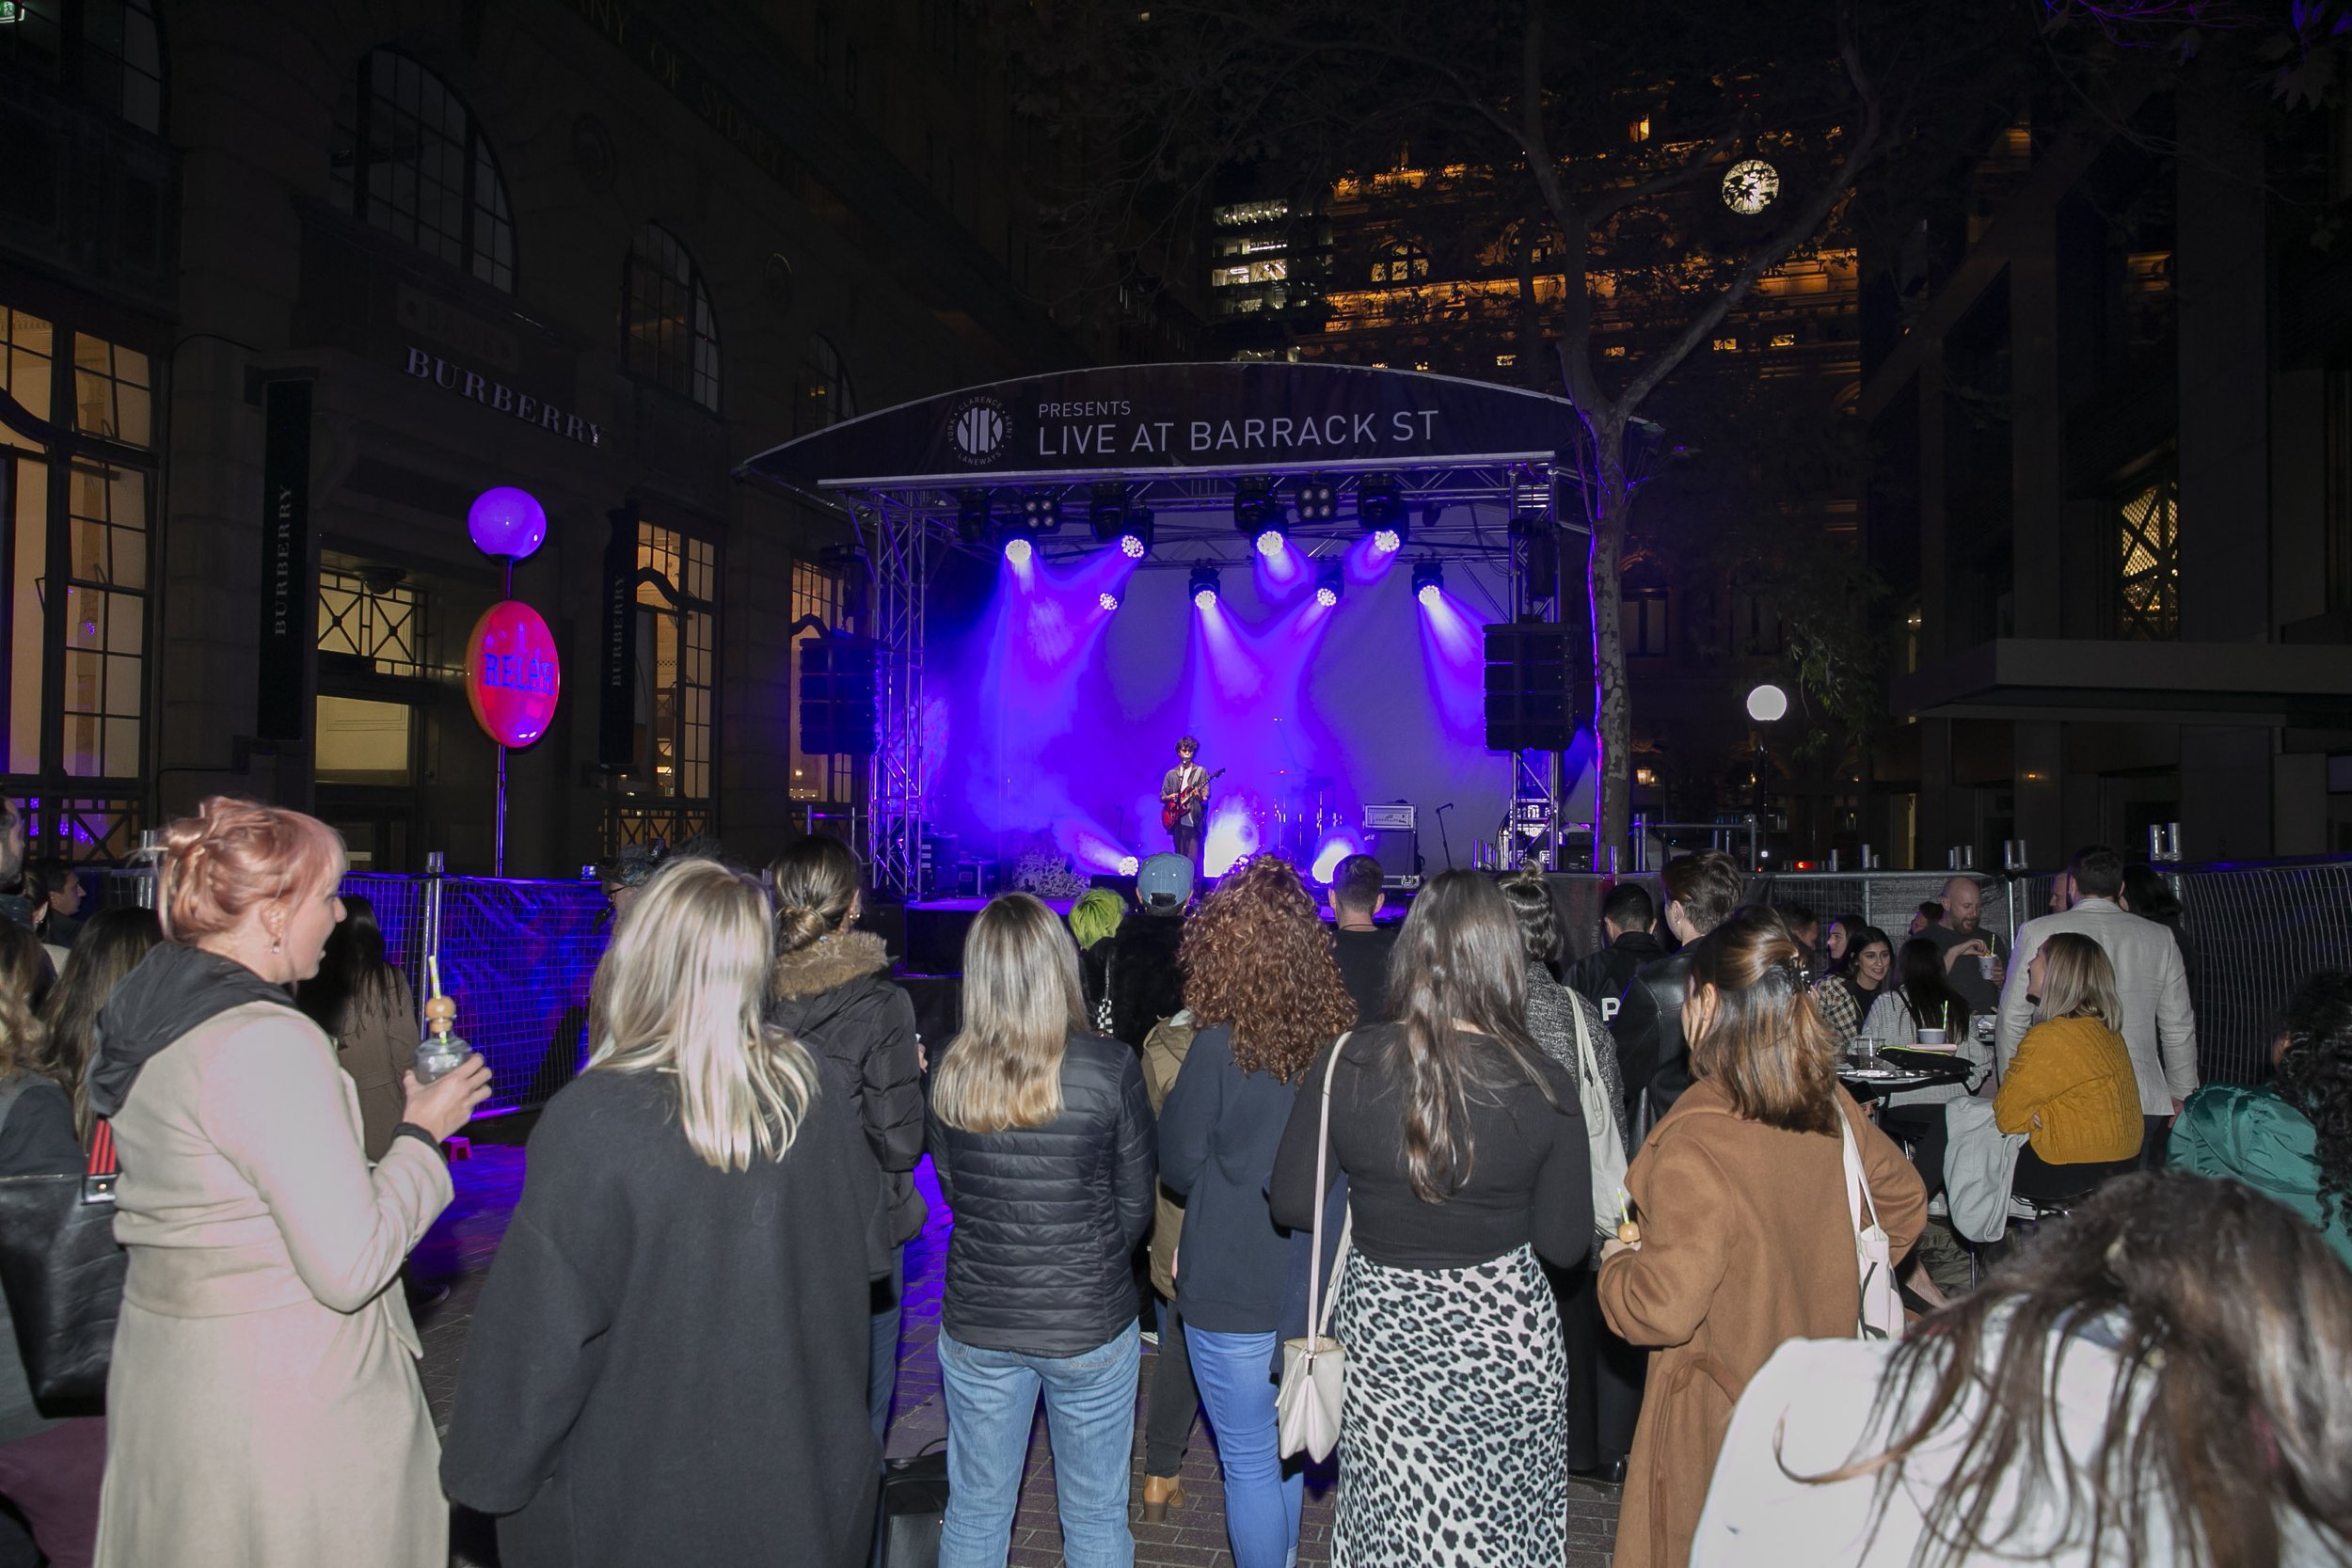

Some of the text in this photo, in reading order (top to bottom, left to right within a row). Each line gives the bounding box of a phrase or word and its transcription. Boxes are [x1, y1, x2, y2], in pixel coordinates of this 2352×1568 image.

[403, 345, 606, 448] BURBERRY
[959, 396, 1003, 411] CLARENCE
[1039, 401, 1131, 419] PRESENTS
[947, 419, 957, 443] YORK
[1004, 415, 1013, 439] KENT
[1040, 410, 1438, 455] LIVE AT BARRACK ST
[958, 451, 1002, 467] LANEWAYS
[274, 484, 292, 637] BURBERRY
[612, 574, 625, 687] BURBERRY
